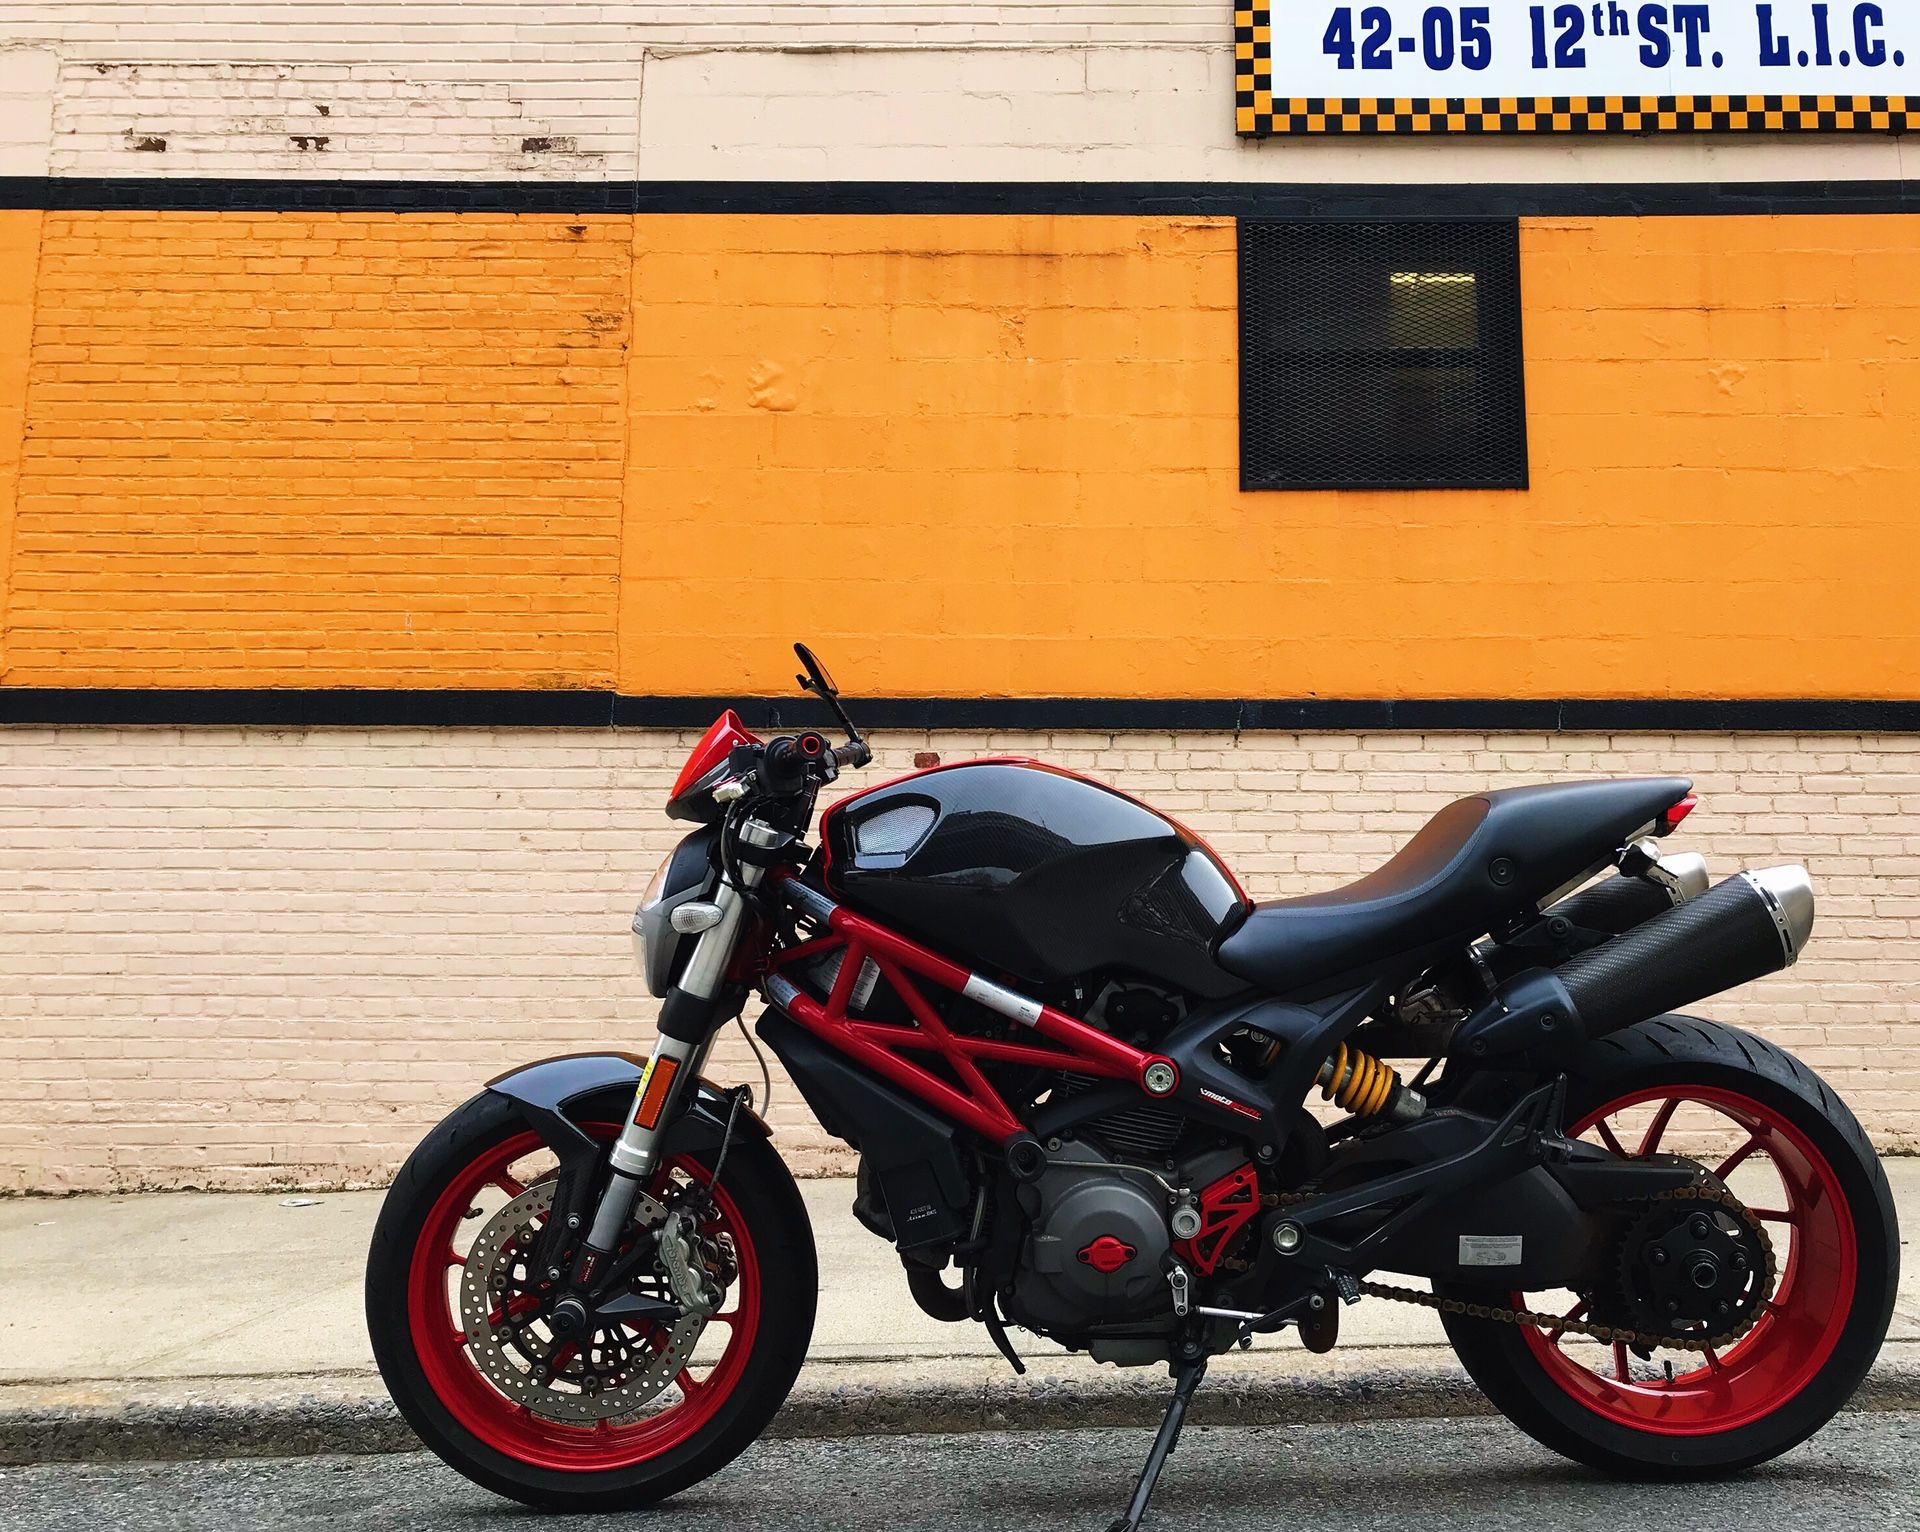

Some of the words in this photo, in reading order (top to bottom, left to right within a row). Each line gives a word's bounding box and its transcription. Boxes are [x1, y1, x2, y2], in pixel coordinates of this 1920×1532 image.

[1323, 7, 1492, 70] 42-05
[1530, 1, 1629, 68] 12th
[1638, 4, 1724, 68] ST.
[1756, 3, 1905, 67] L.I.C.
